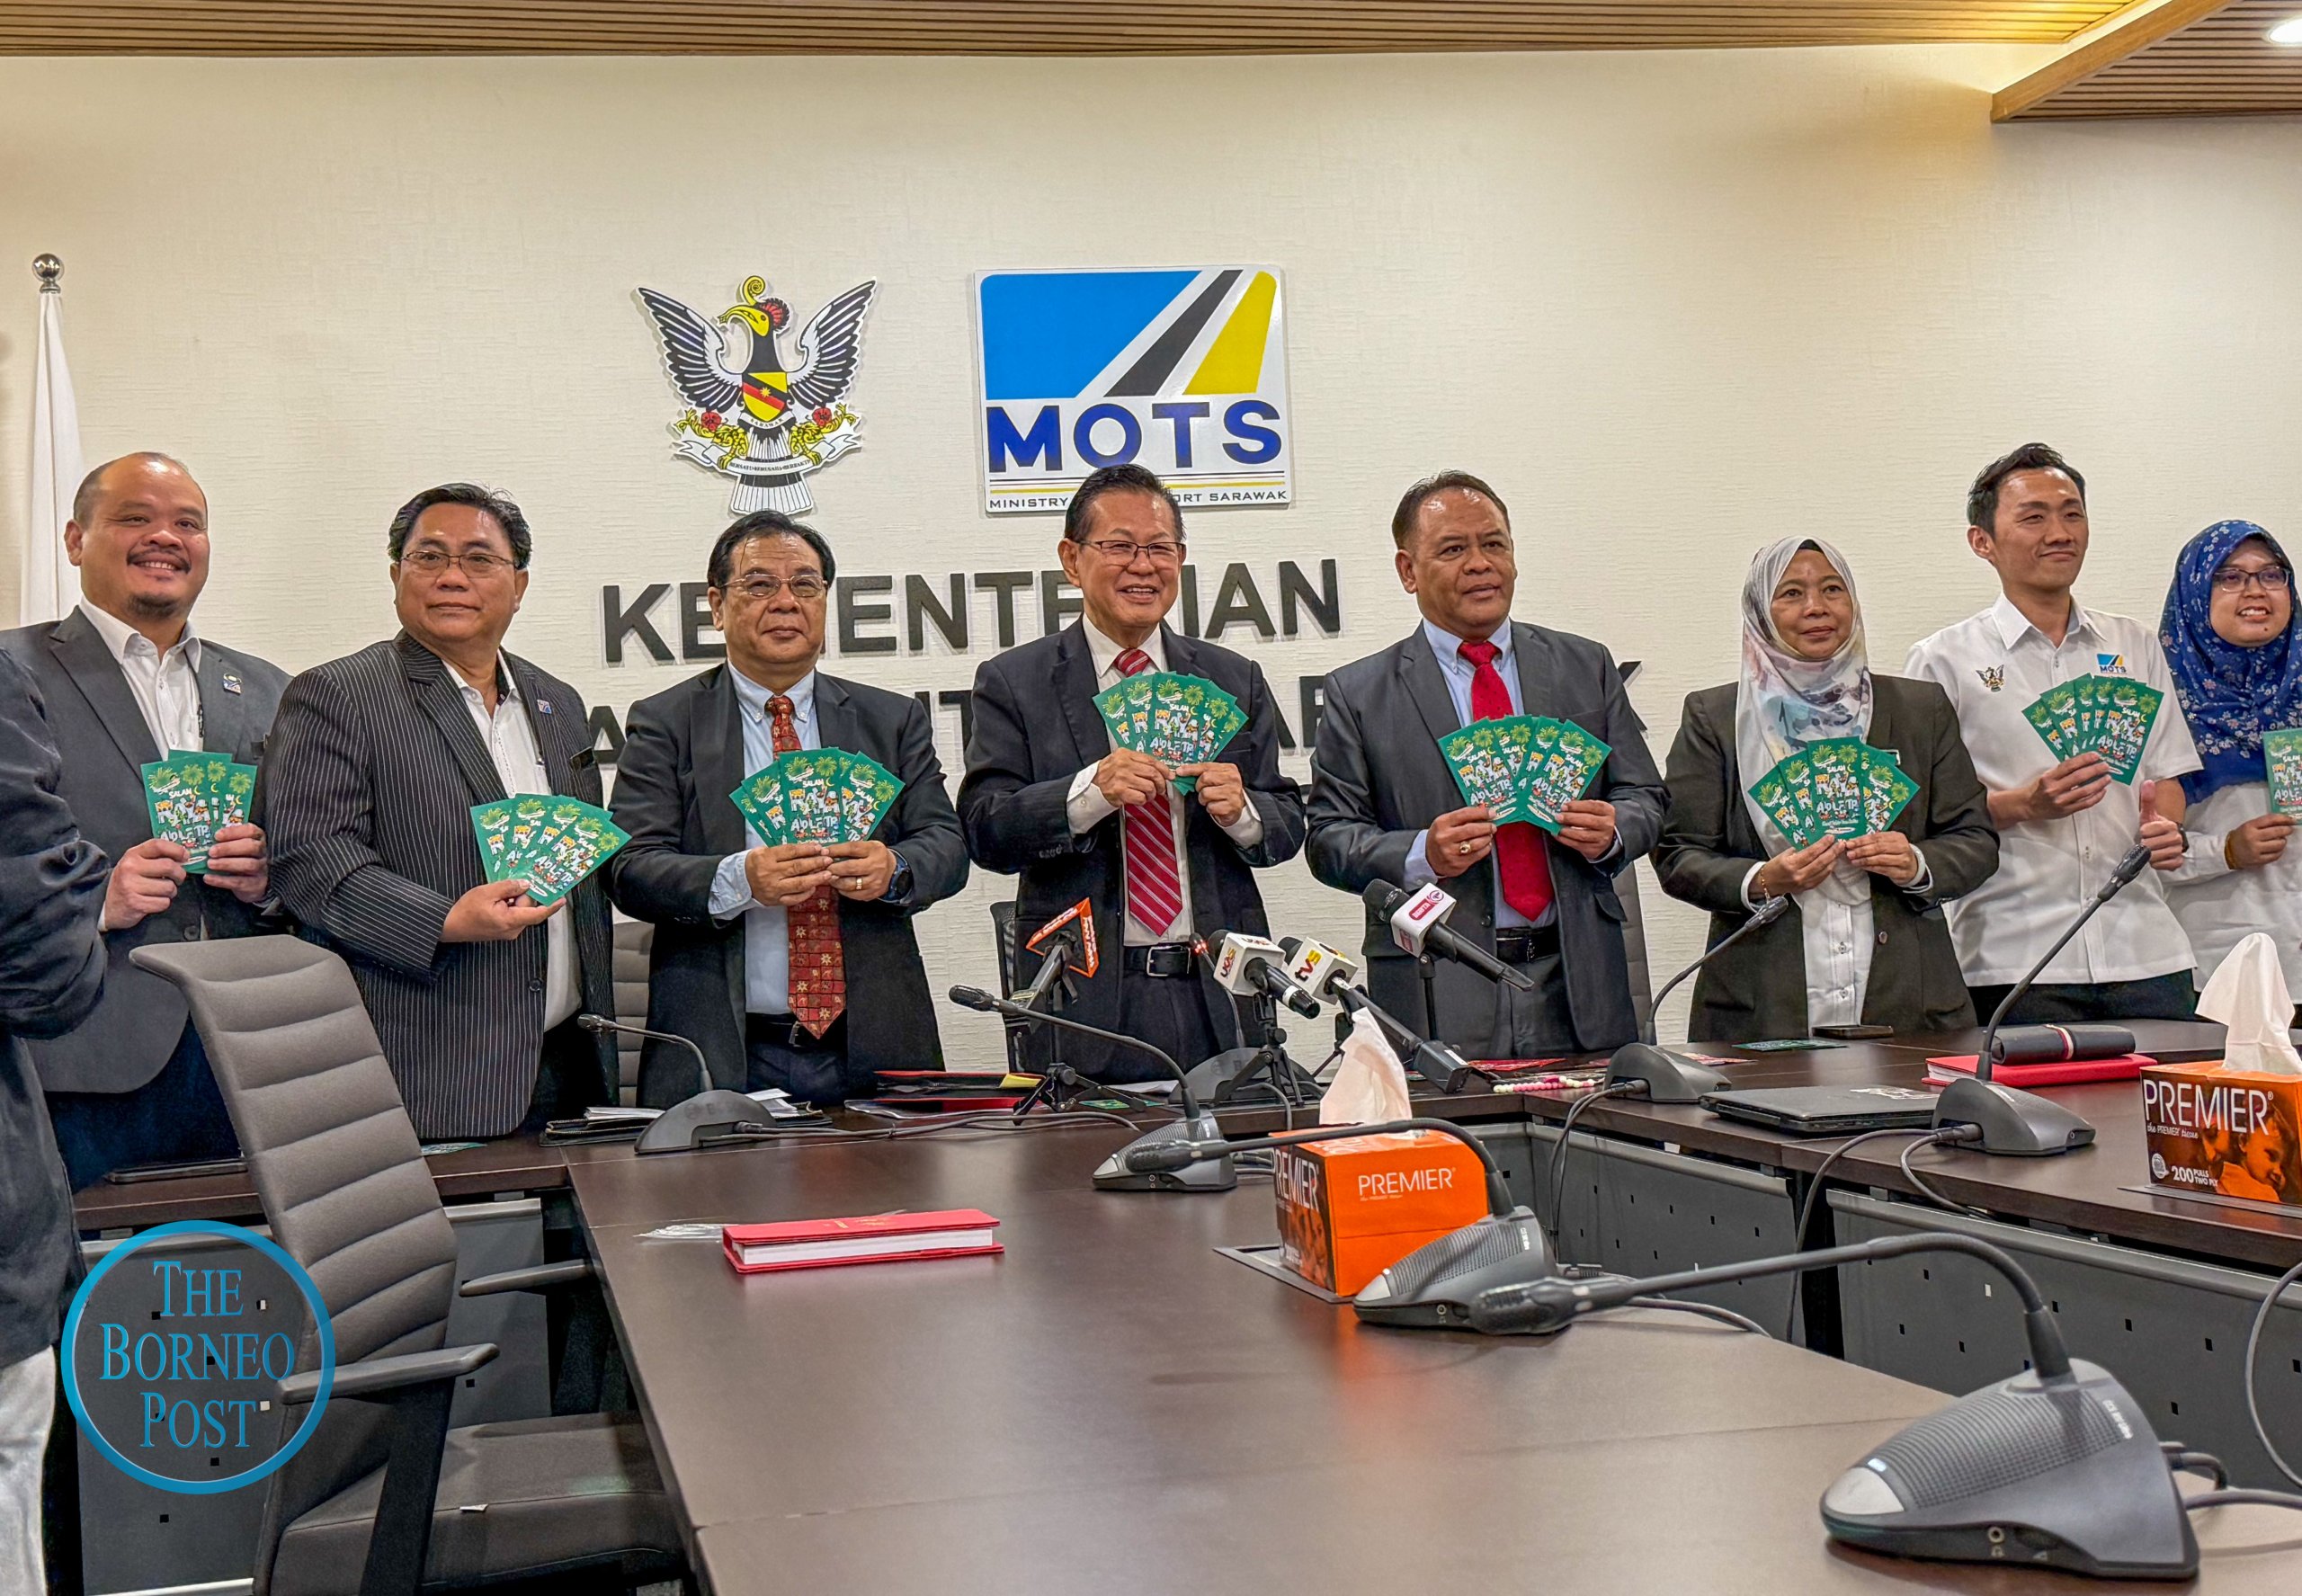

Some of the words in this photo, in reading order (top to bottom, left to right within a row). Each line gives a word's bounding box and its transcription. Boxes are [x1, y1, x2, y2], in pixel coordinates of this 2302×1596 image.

[986, 400, 1282, 473] MOTS
[990, 496, 1068, 509] MINISTRY
[1209, 490, 1287, 502] SARAWAK
[602, 558, 1341, 663] KEENTEIAN
[2143, 1079, 2270, 1136] PREMIER
[1274, 1148, 1319, 1213] REMIER
[1358, 1168, 1453, 1196] PREMIER
[2172, 1165, 2194, 1183] 200
